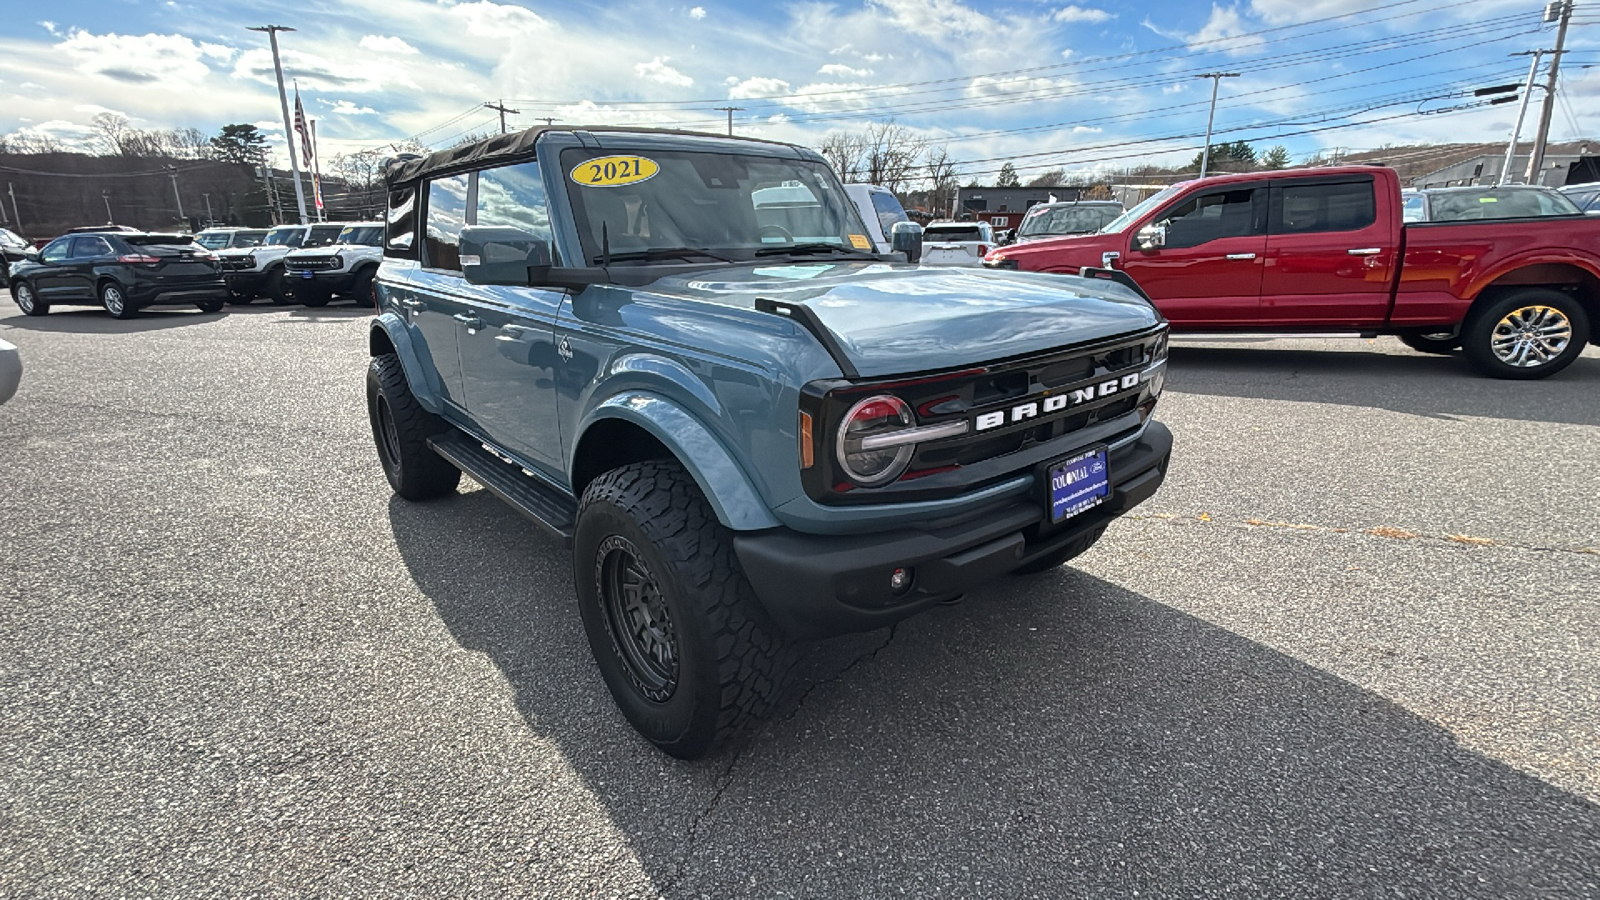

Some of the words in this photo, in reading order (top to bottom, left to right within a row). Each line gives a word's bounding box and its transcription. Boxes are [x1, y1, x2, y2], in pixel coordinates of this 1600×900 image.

[590, 160, 642, 182] 2021
[976, 372, 1139, 431] BRONCO
[1052, 466, 1089, 491] COLONIAL
